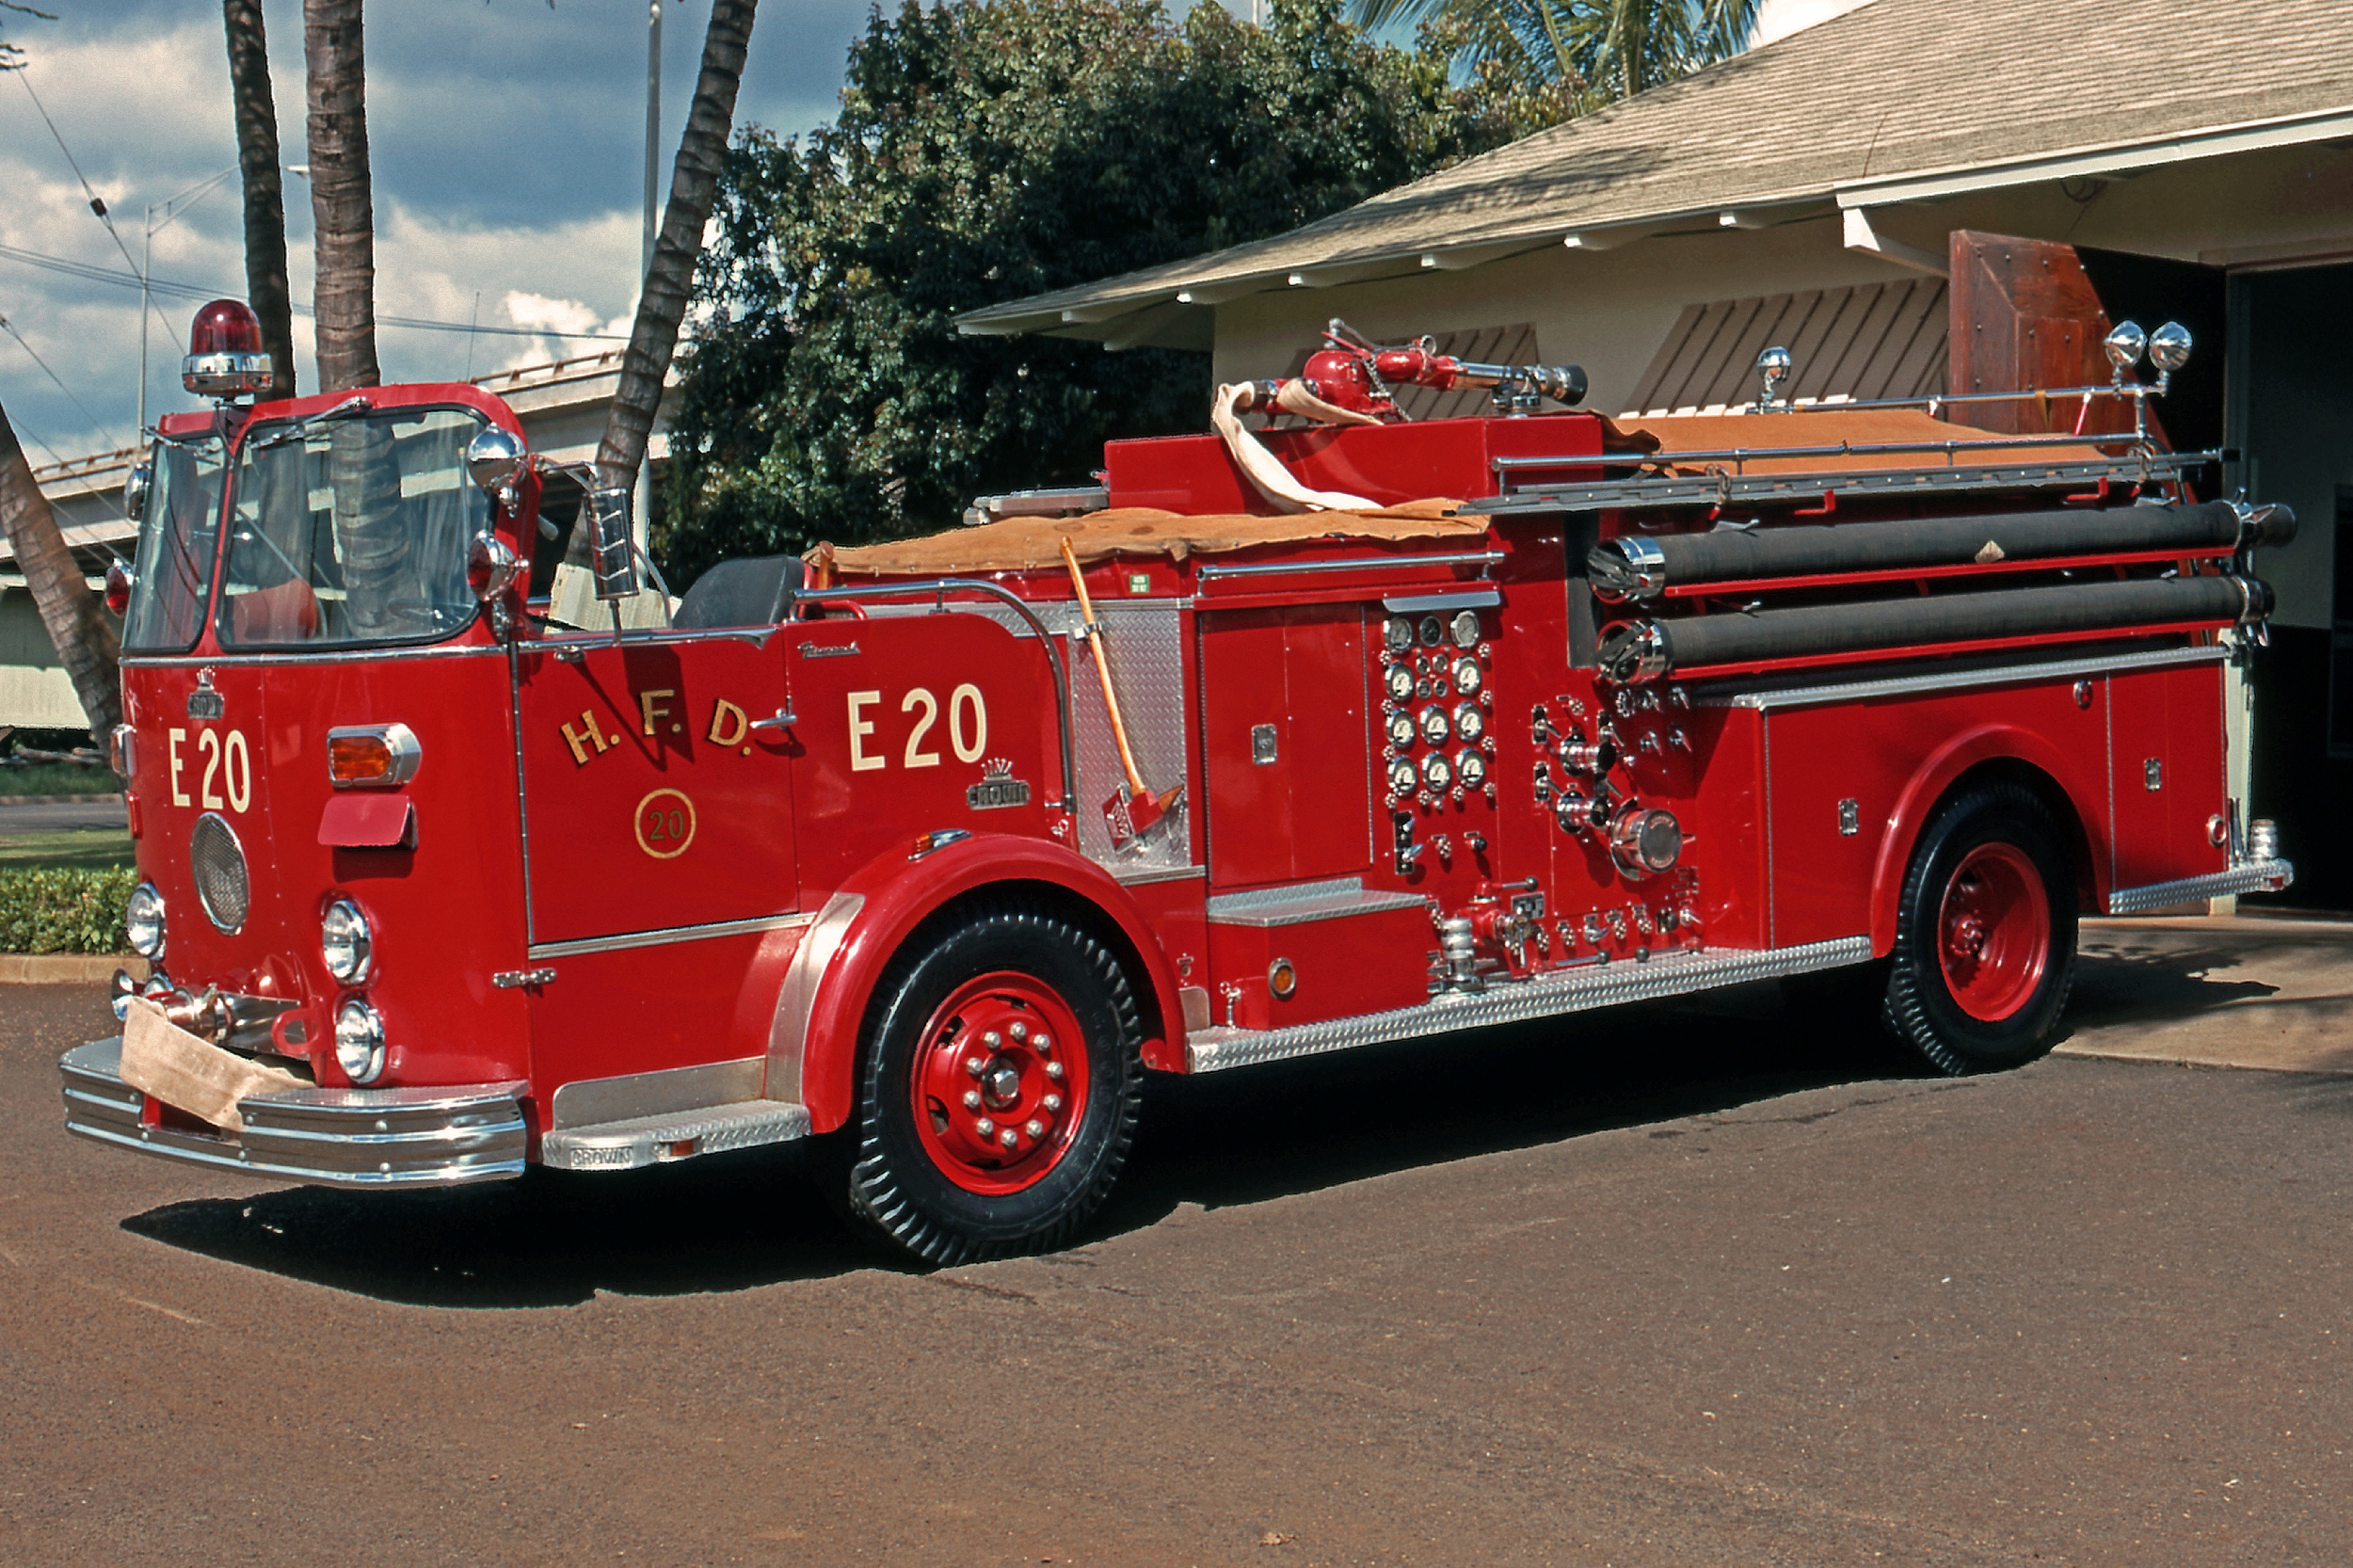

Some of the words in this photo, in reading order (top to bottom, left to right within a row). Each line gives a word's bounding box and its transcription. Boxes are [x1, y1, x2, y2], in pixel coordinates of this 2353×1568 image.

[559, 709, 620, 765] H.
[640, 689, 681, 736] F.
[709, 698, 752, 756] D.
[848, 690, 886, 772] E
[901, 682, 987, 768] 20
[168, 728, 191, 807] E
[199, 728, 250, 813] 20
[967, 782, 1030, 808] CROWN
[648, 809, 684, 840] 20
[572, 1147, 632, 1166] CROWN
